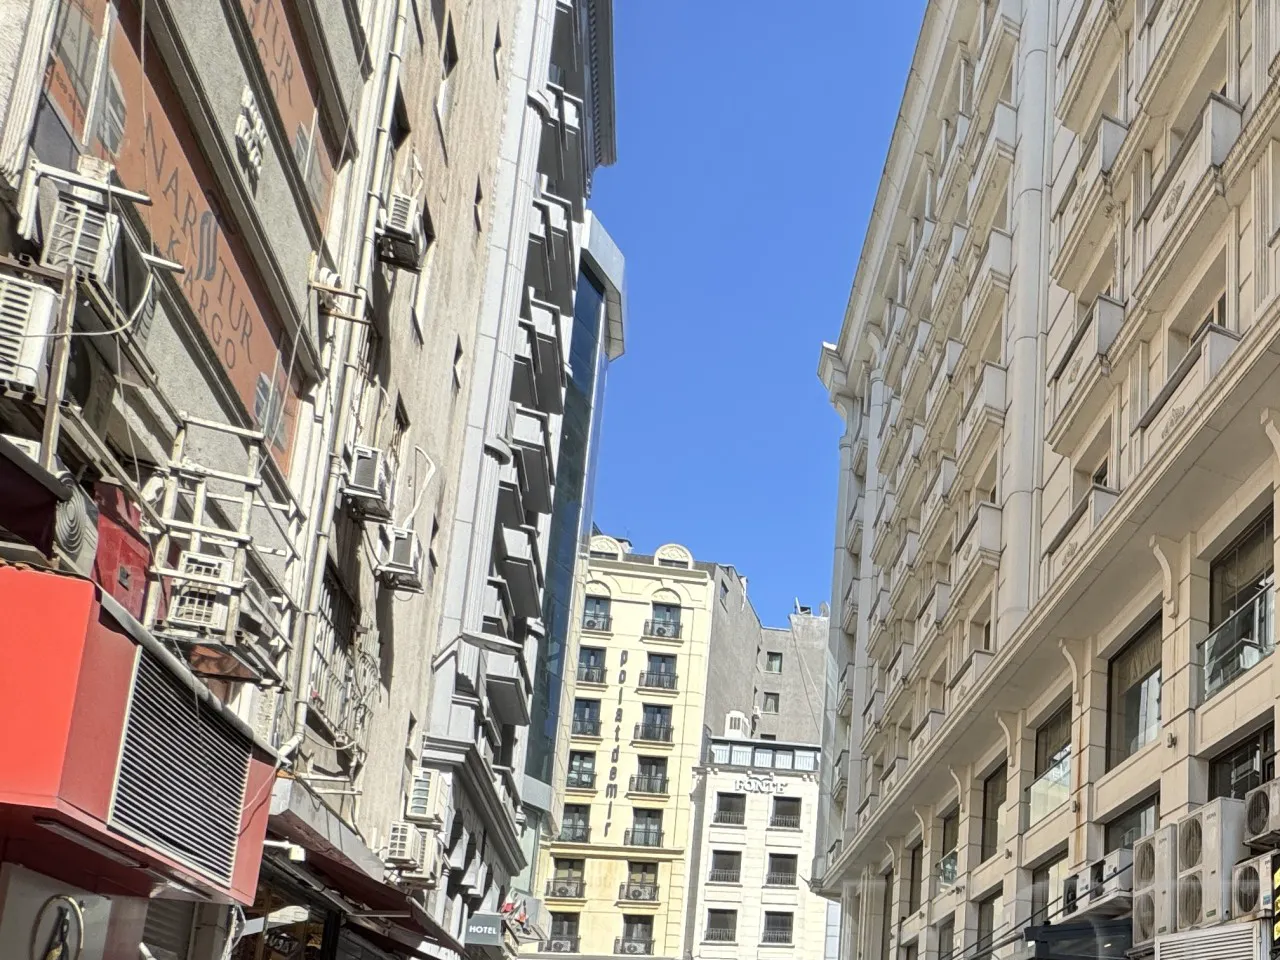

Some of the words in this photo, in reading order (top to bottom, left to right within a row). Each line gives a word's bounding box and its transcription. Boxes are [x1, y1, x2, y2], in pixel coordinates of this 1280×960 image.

[166, 225, 237, 370] KARGO
[216, 255, 254, 365] TUR
[469, 924, 498, 936] HOTEL
